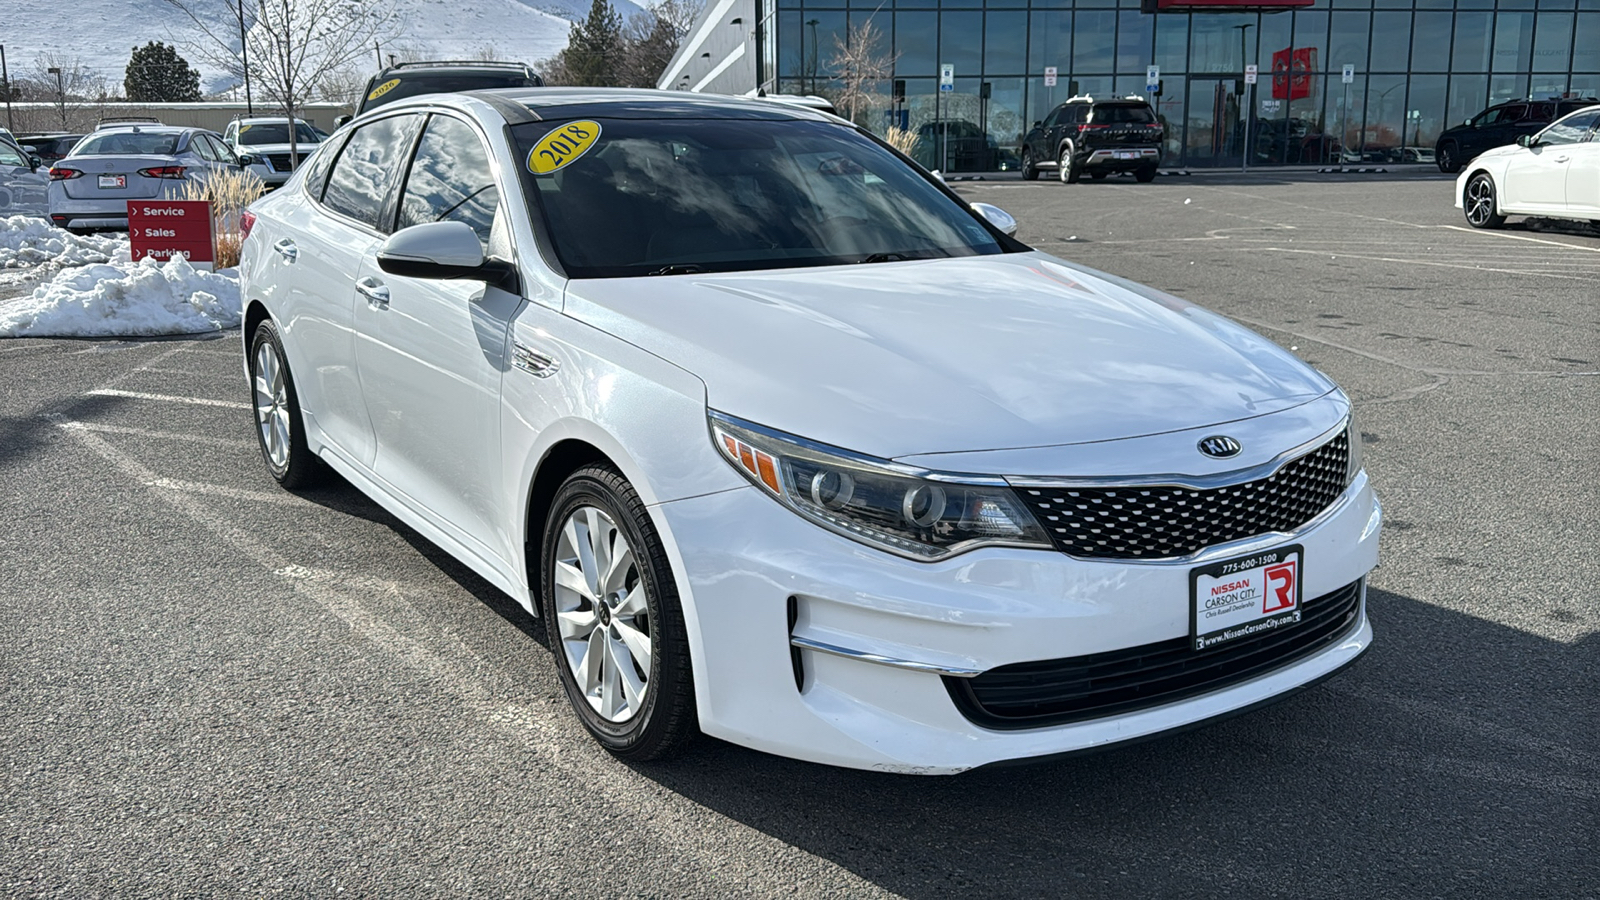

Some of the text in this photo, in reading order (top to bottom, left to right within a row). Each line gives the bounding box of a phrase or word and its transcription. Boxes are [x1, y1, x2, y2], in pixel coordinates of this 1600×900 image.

[373, 81, 395, 97] 2026
[539, 125, 590, 166] 2018
[143, 206, 185, 216] Service
[145, 228, 176, 237] Sales
[147, 248, 191, 260] Parkig
[1203, 437, 1239, 454] KIA
[1222, 553, 1277, 574] 775-600-1500
[1211, 578, 1250, 596] NISSAN
[1205, 587, 1256, 609] CARSON CITY
[1205, 615, 1293, 646] www.NissanCarsonCity.com
